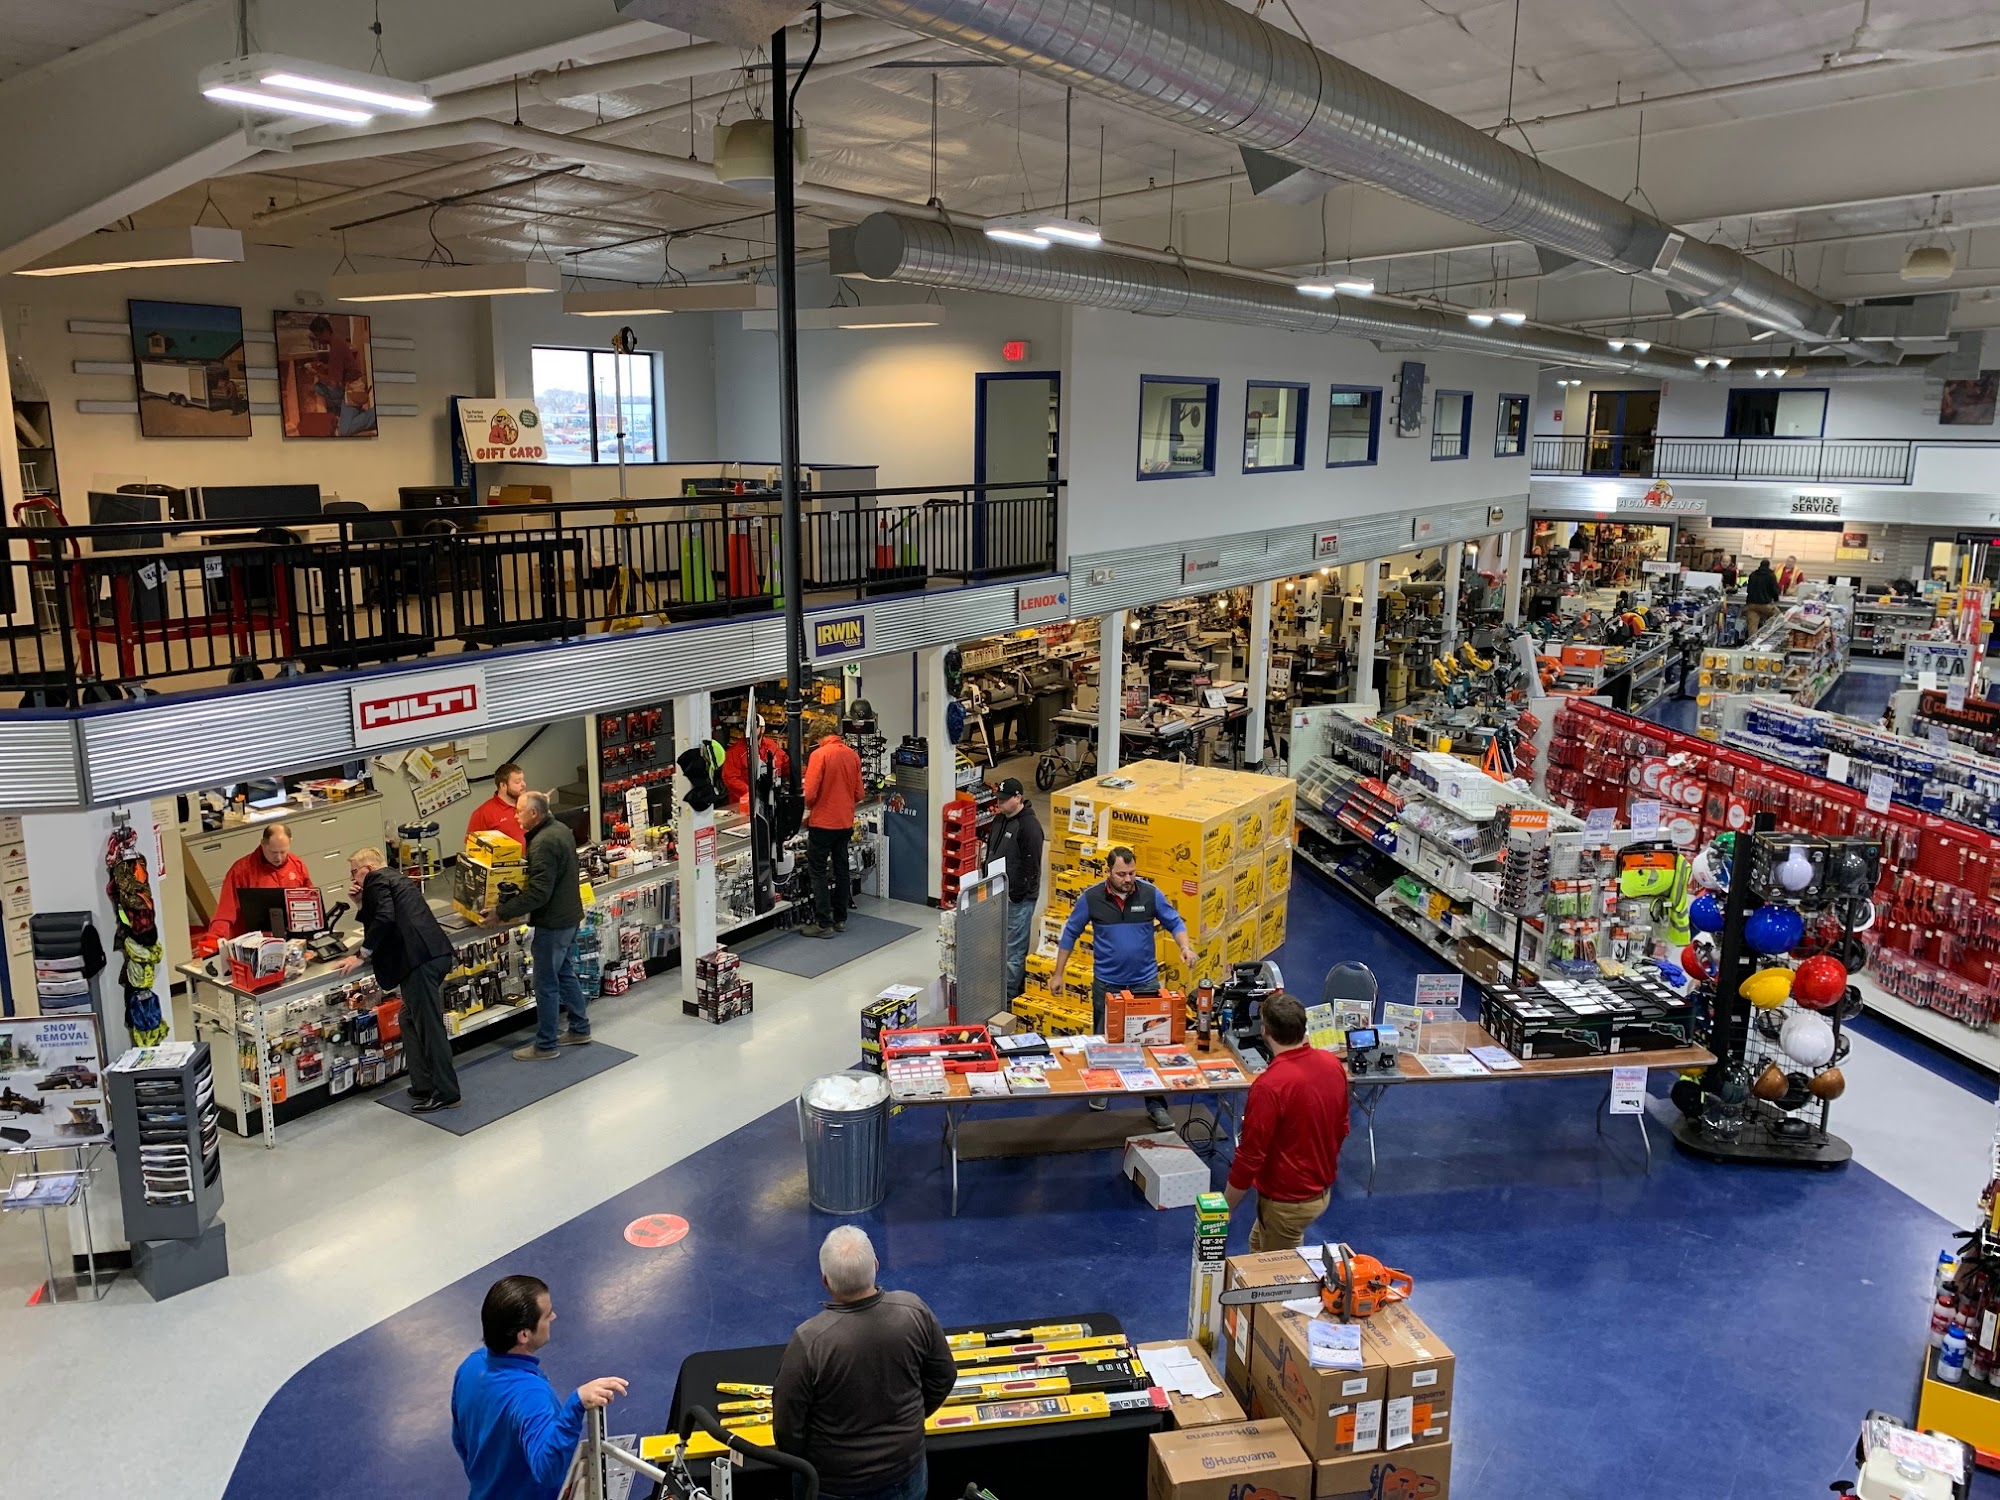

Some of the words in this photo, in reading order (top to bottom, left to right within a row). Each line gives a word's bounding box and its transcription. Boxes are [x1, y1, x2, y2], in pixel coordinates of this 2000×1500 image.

[476, 447, 505, 459] GIFT
[509, 446, 542, 459] CARD
[1619, 499, 1655, 508] ACME
[1660, 501, 1704, 510] RENTS
[1799, 496, 1834, 504] PARTS
[1792, 503, 1839, 513] SERVICE
[1320, 541, 1337, 552] JET
[1021, 594, 1057, 610] LENOX
[817, 620, 861, 645] IRWIN
[365, 689, 472, 725] HILTI
[1934, 701, 1993, 724] CRESCENT
[883, 805, 896, 813] OOL
[1112, 810, 1149, 825] DEWALT
[1512, 814, 1546, 824] STIHL
[43, 1023, 77, 1033] SNOW
[35, 1032, 89, 1043] REMOVAL
[1203, 1221, 1226, 1231] Classic
[1257, 1289, 1292, 1298] Husqvarna
[1414, 1390, 1446, 1400] usqvarna
[1215, 1451, 1277, 1466] Husqvarna
